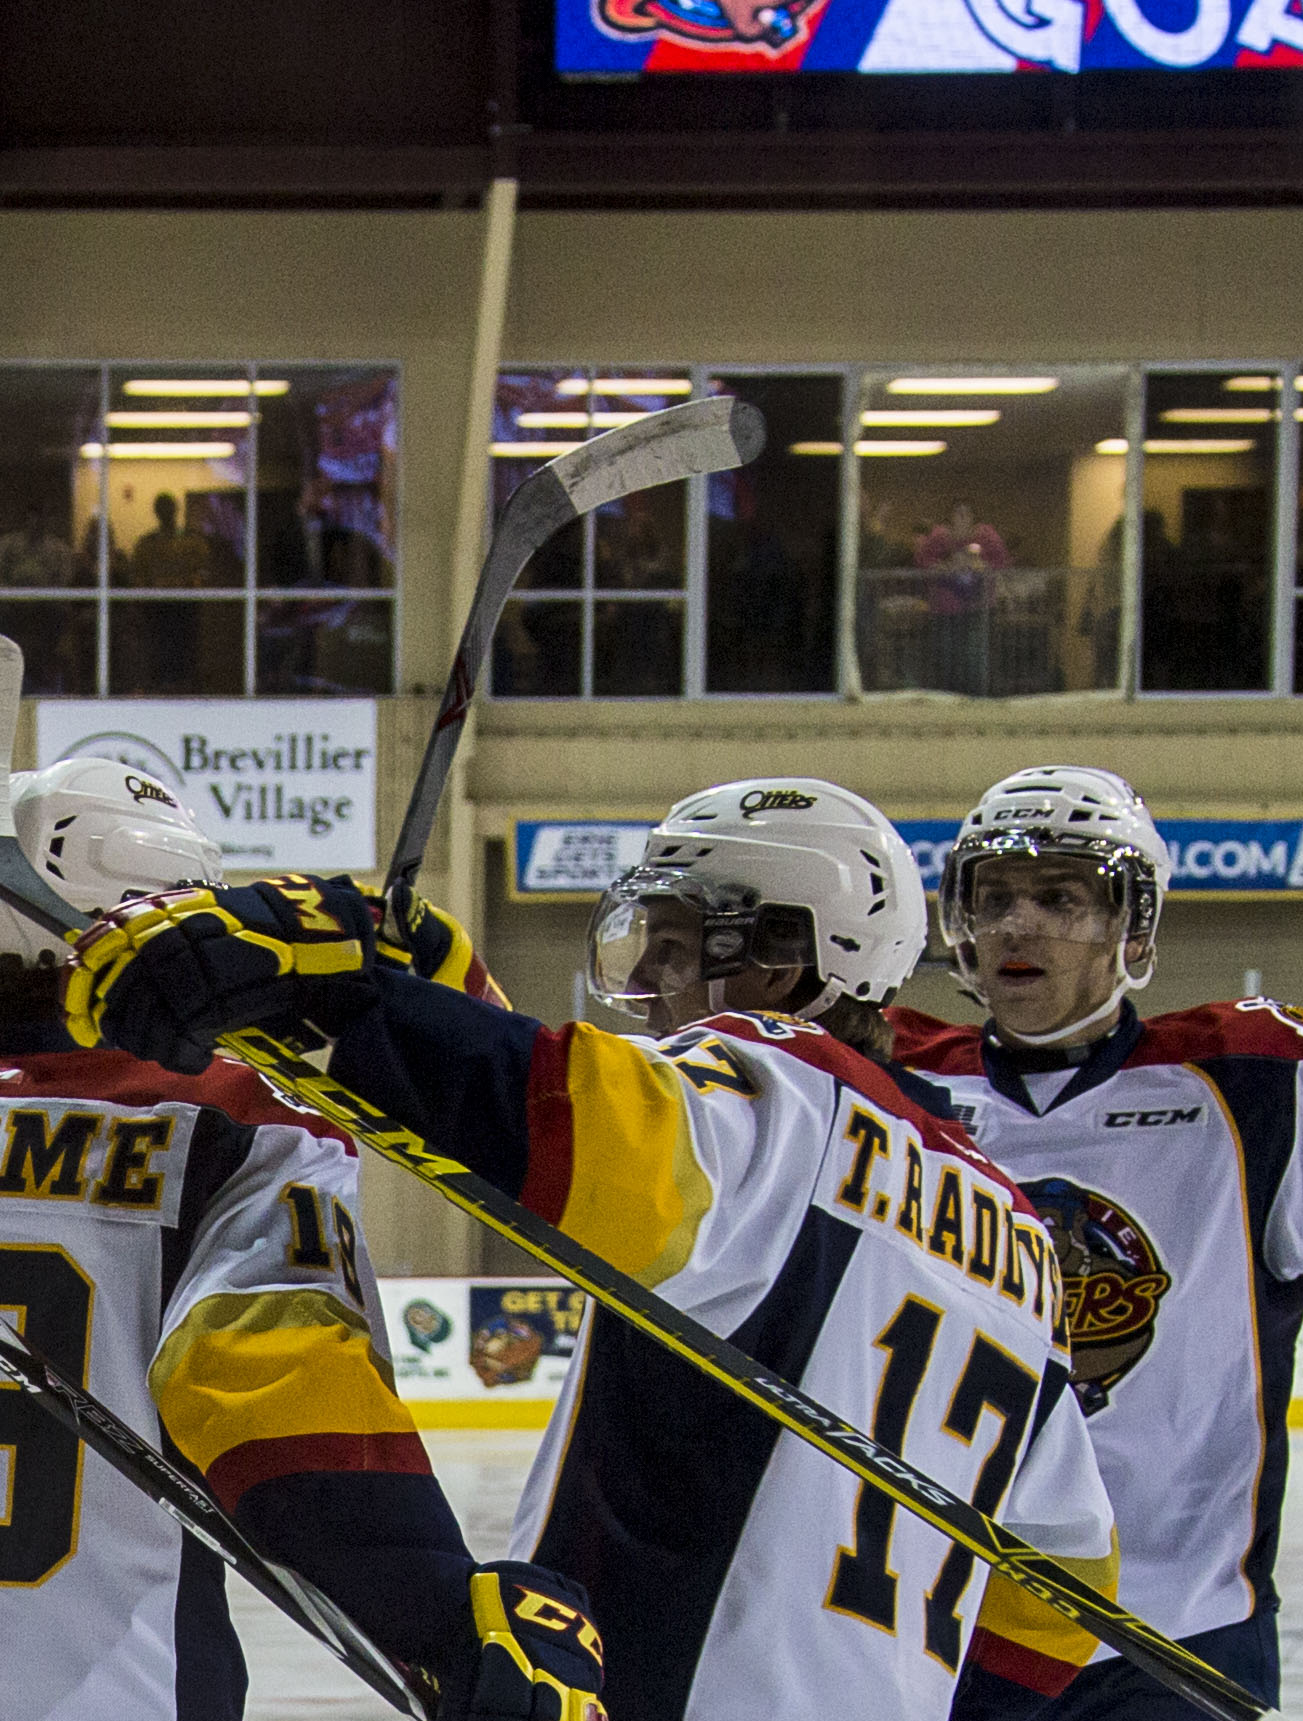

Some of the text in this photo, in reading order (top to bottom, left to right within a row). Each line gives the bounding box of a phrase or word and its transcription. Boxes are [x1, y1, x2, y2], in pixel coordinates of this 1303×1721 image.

[182, 732, 369, 772] Brevillier
[209, 783, 352, 836] Village
[994, 809, 1055, 822] CCM
[1103, 1105, 1204, 1128] CCM
[821, 1290, 1042, 1680] 17
